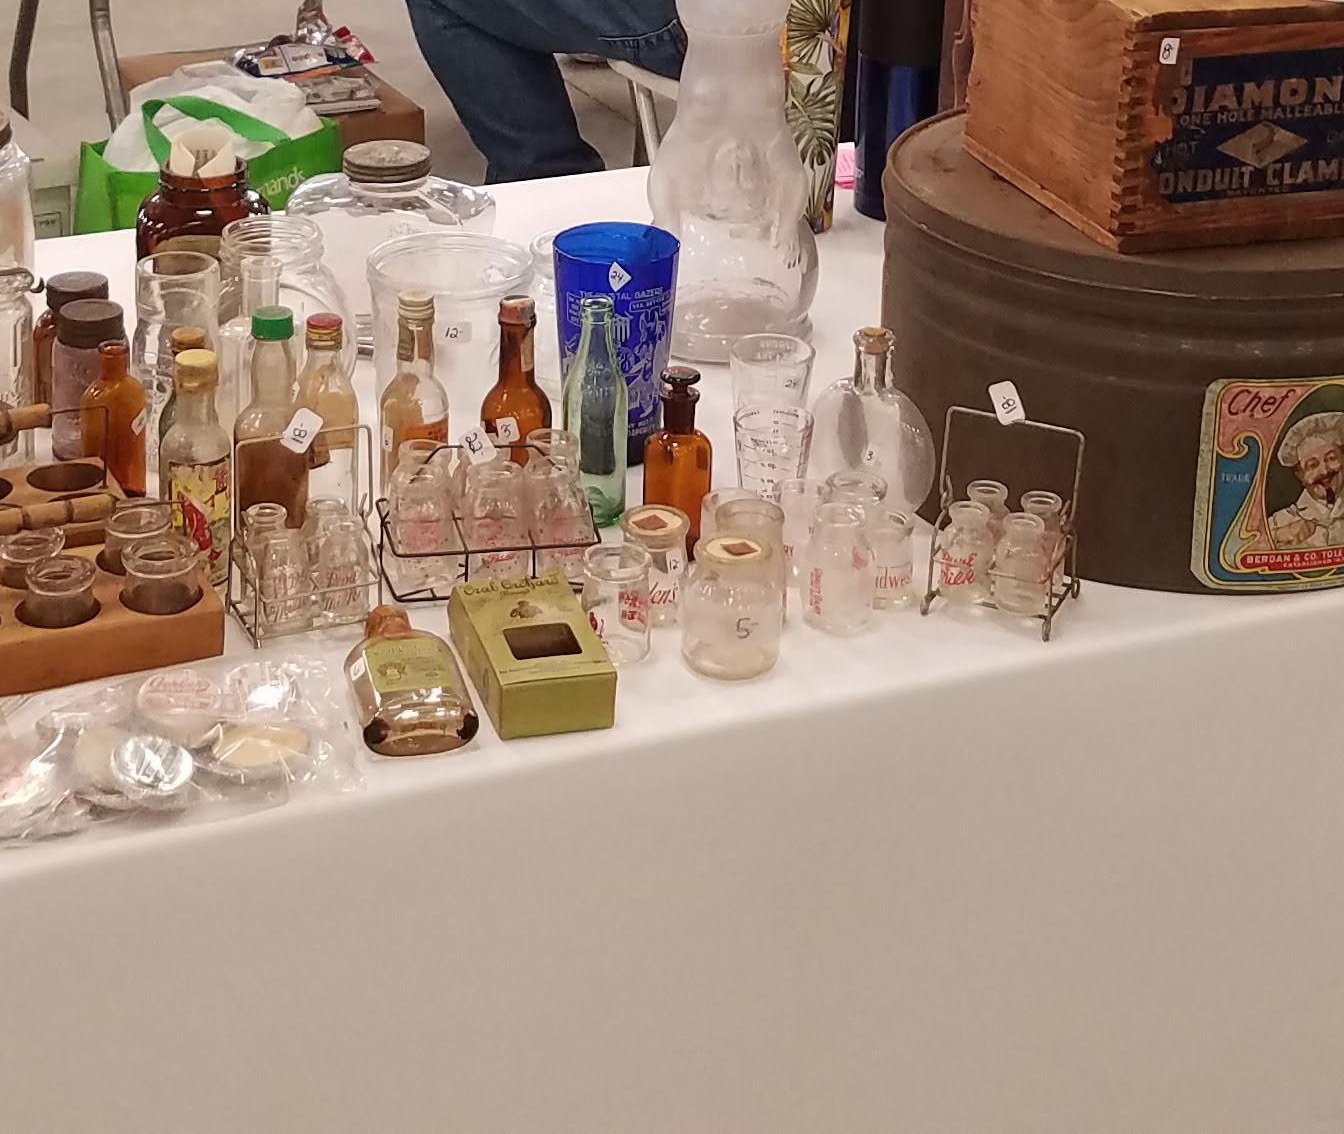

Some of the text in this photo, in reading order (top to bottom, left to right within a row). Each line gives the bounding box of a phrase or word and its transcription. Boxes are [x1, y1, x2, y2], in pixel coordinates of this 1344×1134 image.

[1178, 112, 1213, 127] ONE
[1216, 110, 1255, 124] HOLE
[1158, 166, 1256, 195] ONDUIT
[1227, 387, 1297, 419] Chef
[1246, 554, 1291, 564] BERDAN
